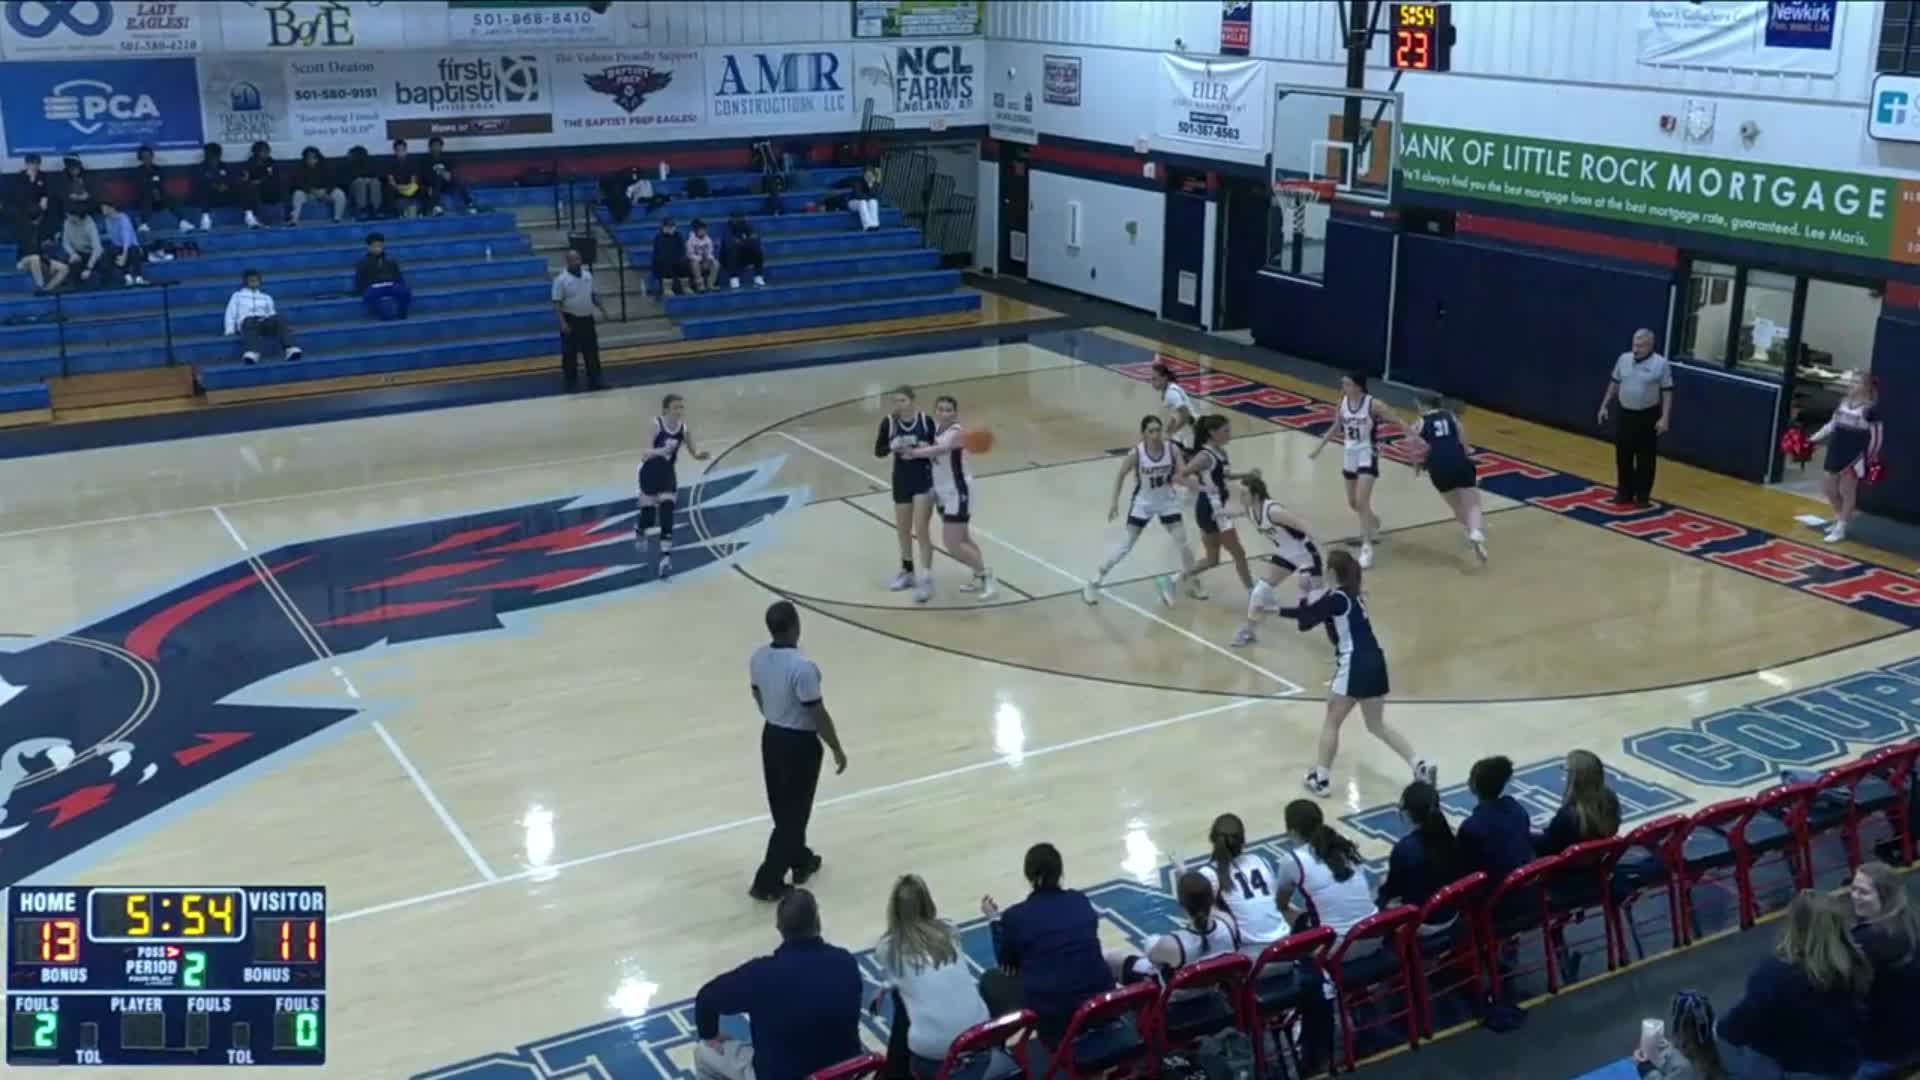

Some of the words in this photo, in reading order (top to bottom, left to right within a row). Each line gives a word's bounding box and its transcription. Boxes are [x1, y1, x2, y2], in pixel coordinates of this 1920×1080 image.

[136, 4, 177, 16] LADY
[1400, 5, 1435, 26] 5:54
[1771, 2, 1831, 22] Newkirk
[126, 16, 190, 31] EAGLES!
[897, 46, 974, 75] NCL
[1397, 32, 1429, 69] 23
[438, 58, 492, 81] first
[395, 81, 495, 111] baptist
[897, 75, 973, 101] FARMS
[1192, 81, 1229, 102] EILER
[714, 96, 816, 116] CONSTRUCTION
[823, 95, 845, 112] LLC
[1462, 139, 1495, 167] OF
[1503, 144, 1572, 178] LITTLE
[1580, 153, 1659, 189] ROCK
[1666, 162, 1887, 219] MORTGAGE
[1469, 181, 1486, 192] you
[1487, 179, 1502, 192] the
[1503, 181, 1523, 195] best
[1524, 188, 1568, 205] mortgage
[1570, 191, 1593, 205] loan
[1594, 196, 1605, 208] at
[1607, 196, 1623, 211] the
[1624, 198, 1647, 214] best
[1648, 206, 1700, 225] mortgage
[1804, 224, 1826, 240] Lee
[1433, 419, 1450, 437] 31
[1234, 868, 1270, 900] 14
